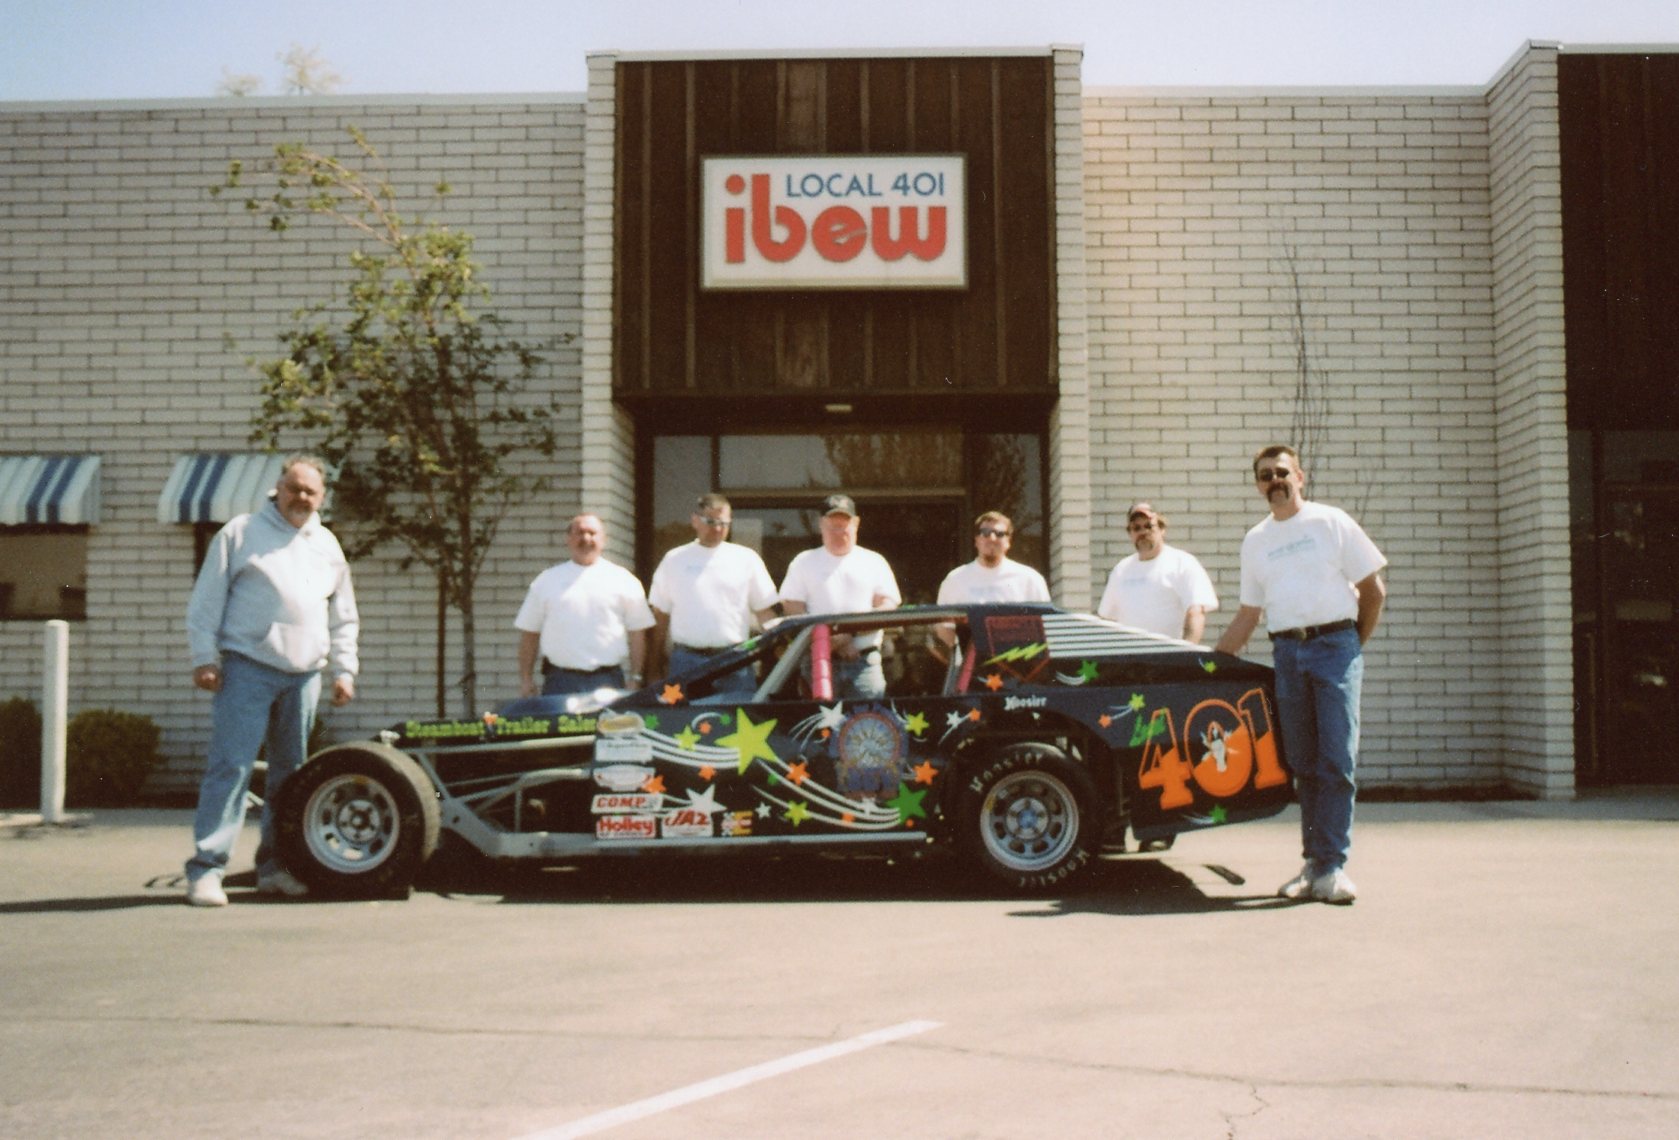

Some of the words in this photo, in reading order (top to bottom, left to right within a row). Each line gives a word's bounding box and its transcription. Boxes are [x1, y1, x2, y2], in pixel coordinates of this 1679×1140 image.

[786, 173, 882, 198] LOCAL
[890, 172, 944, 196] 401
[725, 173, 947, 264] ibew
[1138, 687, 1288, 810] 401
[596, 796, 646, 809] COMP
[599, 815, 654, 836] Holley
